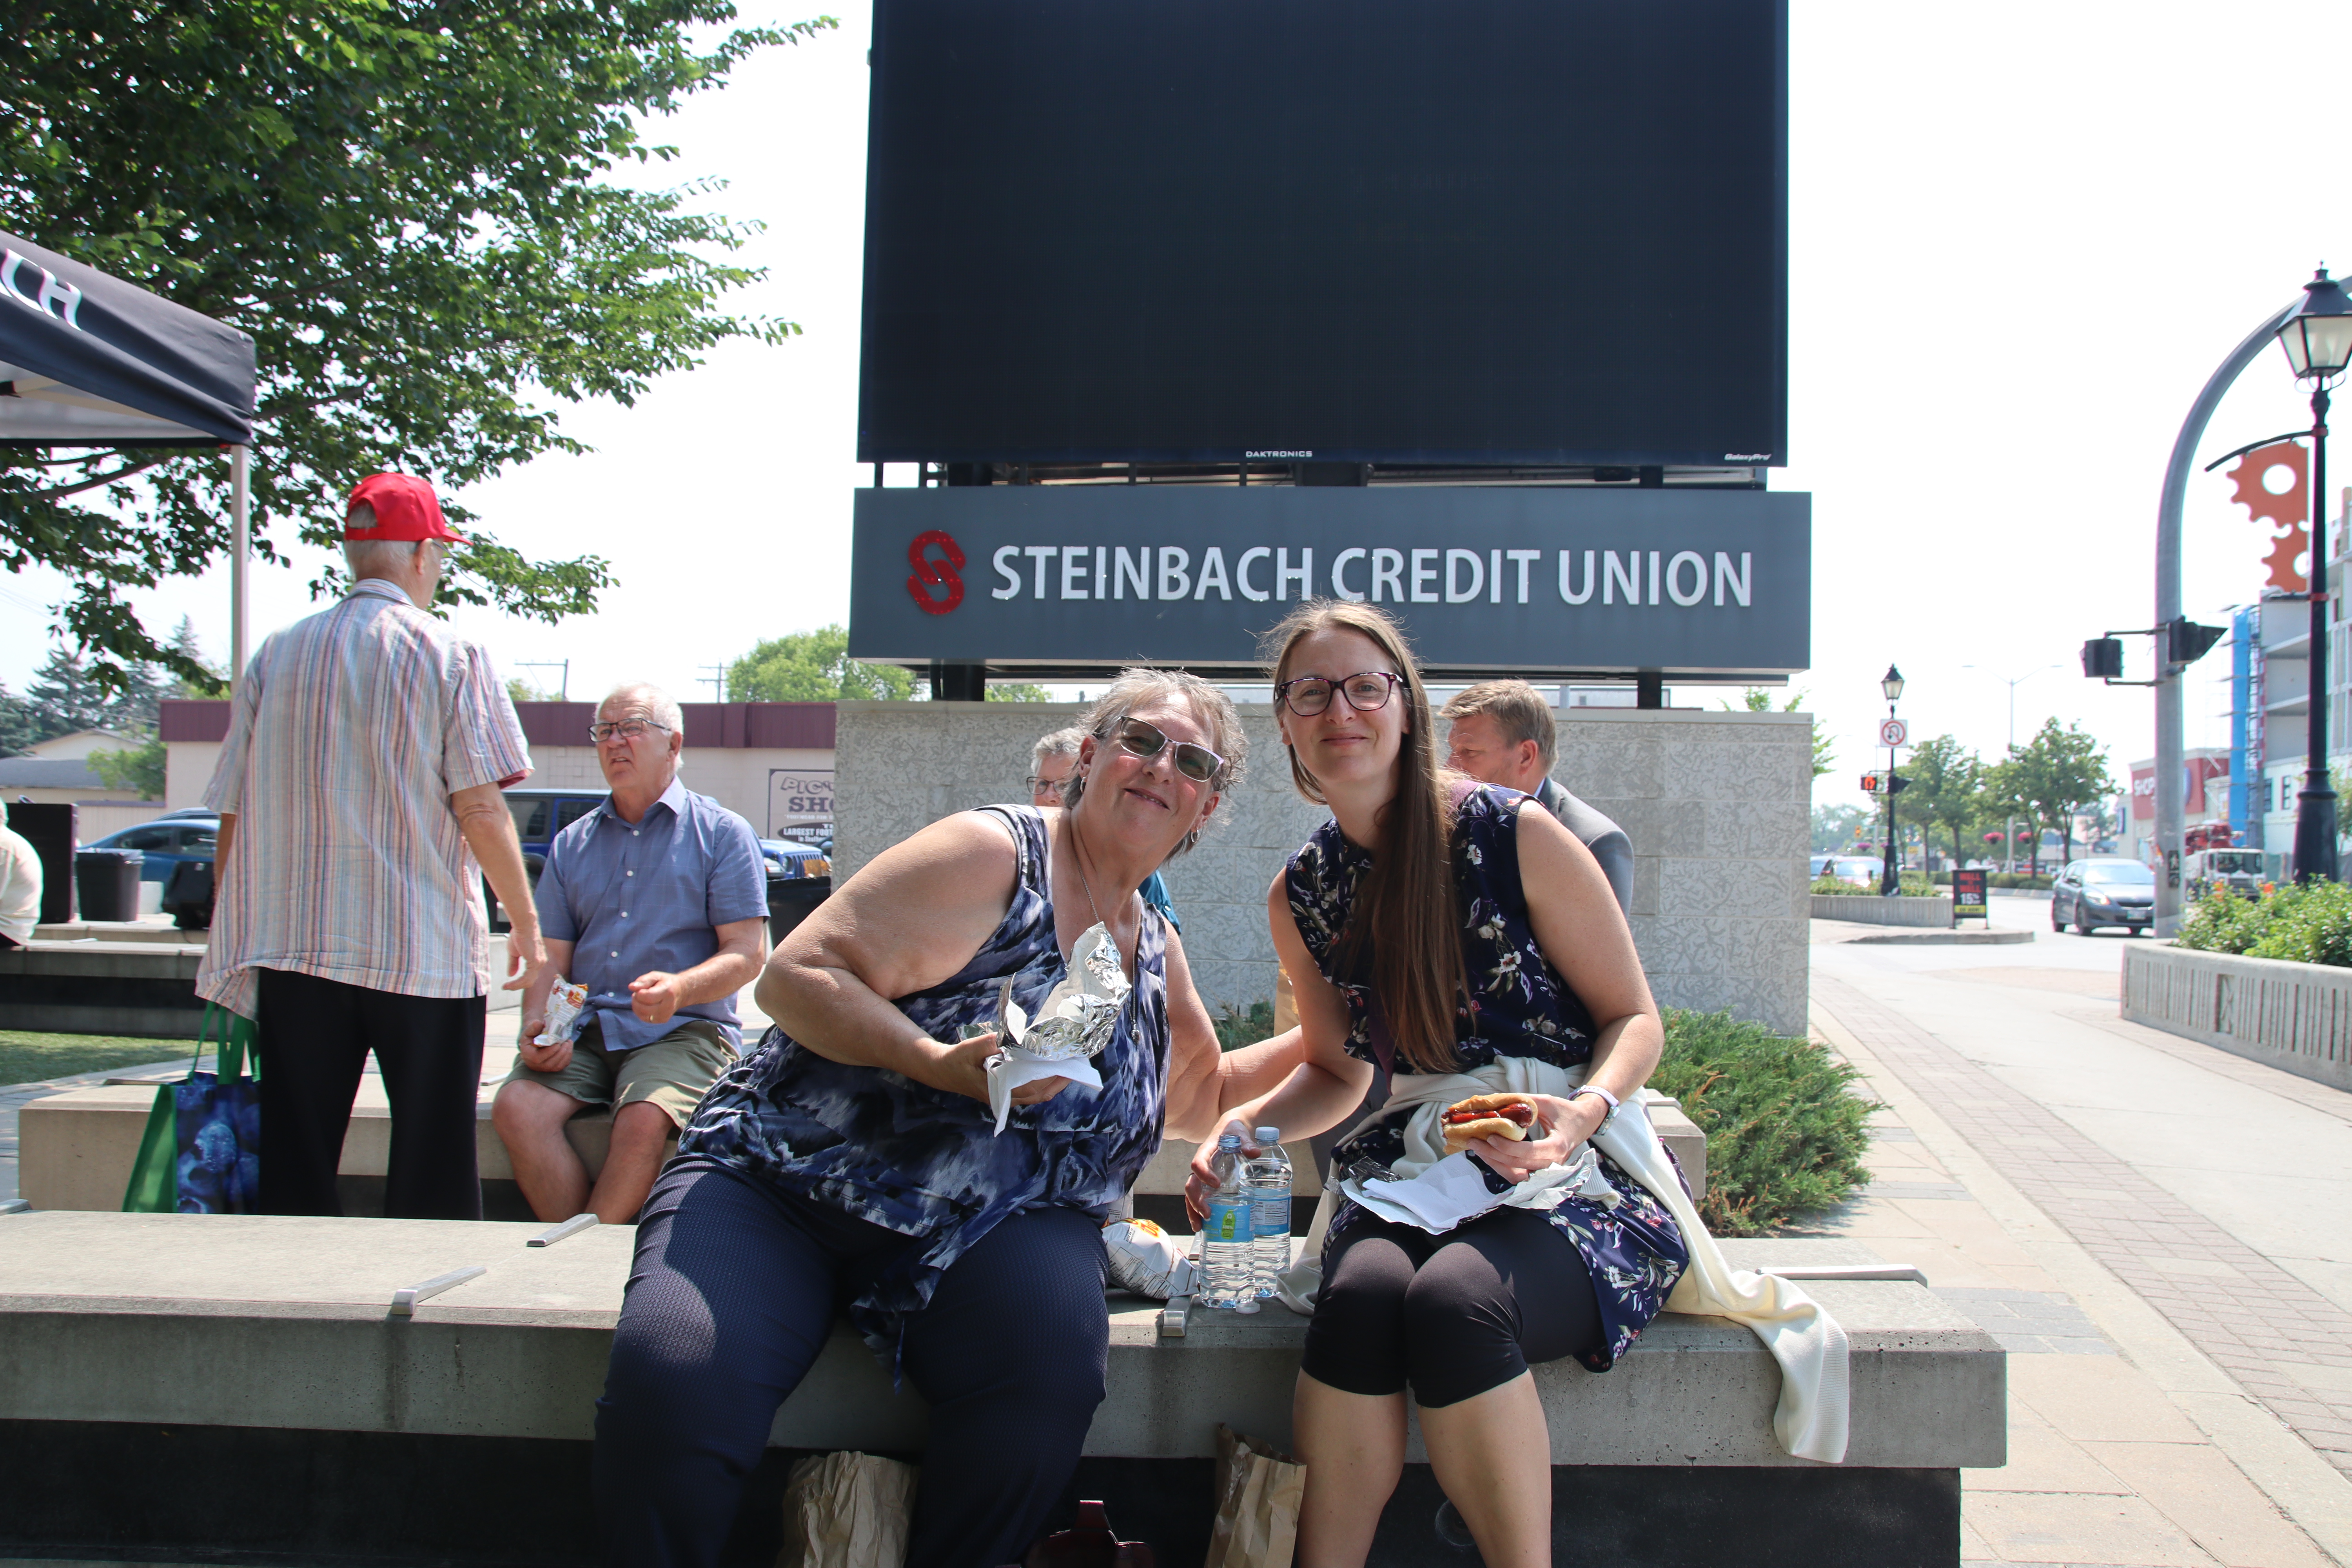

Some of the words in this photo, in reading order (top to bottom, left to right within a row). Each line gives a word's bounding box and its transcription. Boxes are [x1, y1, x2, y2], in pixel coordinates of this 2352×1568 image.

[0, 248, 82, 331] CH
[992, 545, 1312, 601] STEINBACH
[1331, 547, 1540, 604] CREDIT
[1559, 550, 1751, 607] UNION
